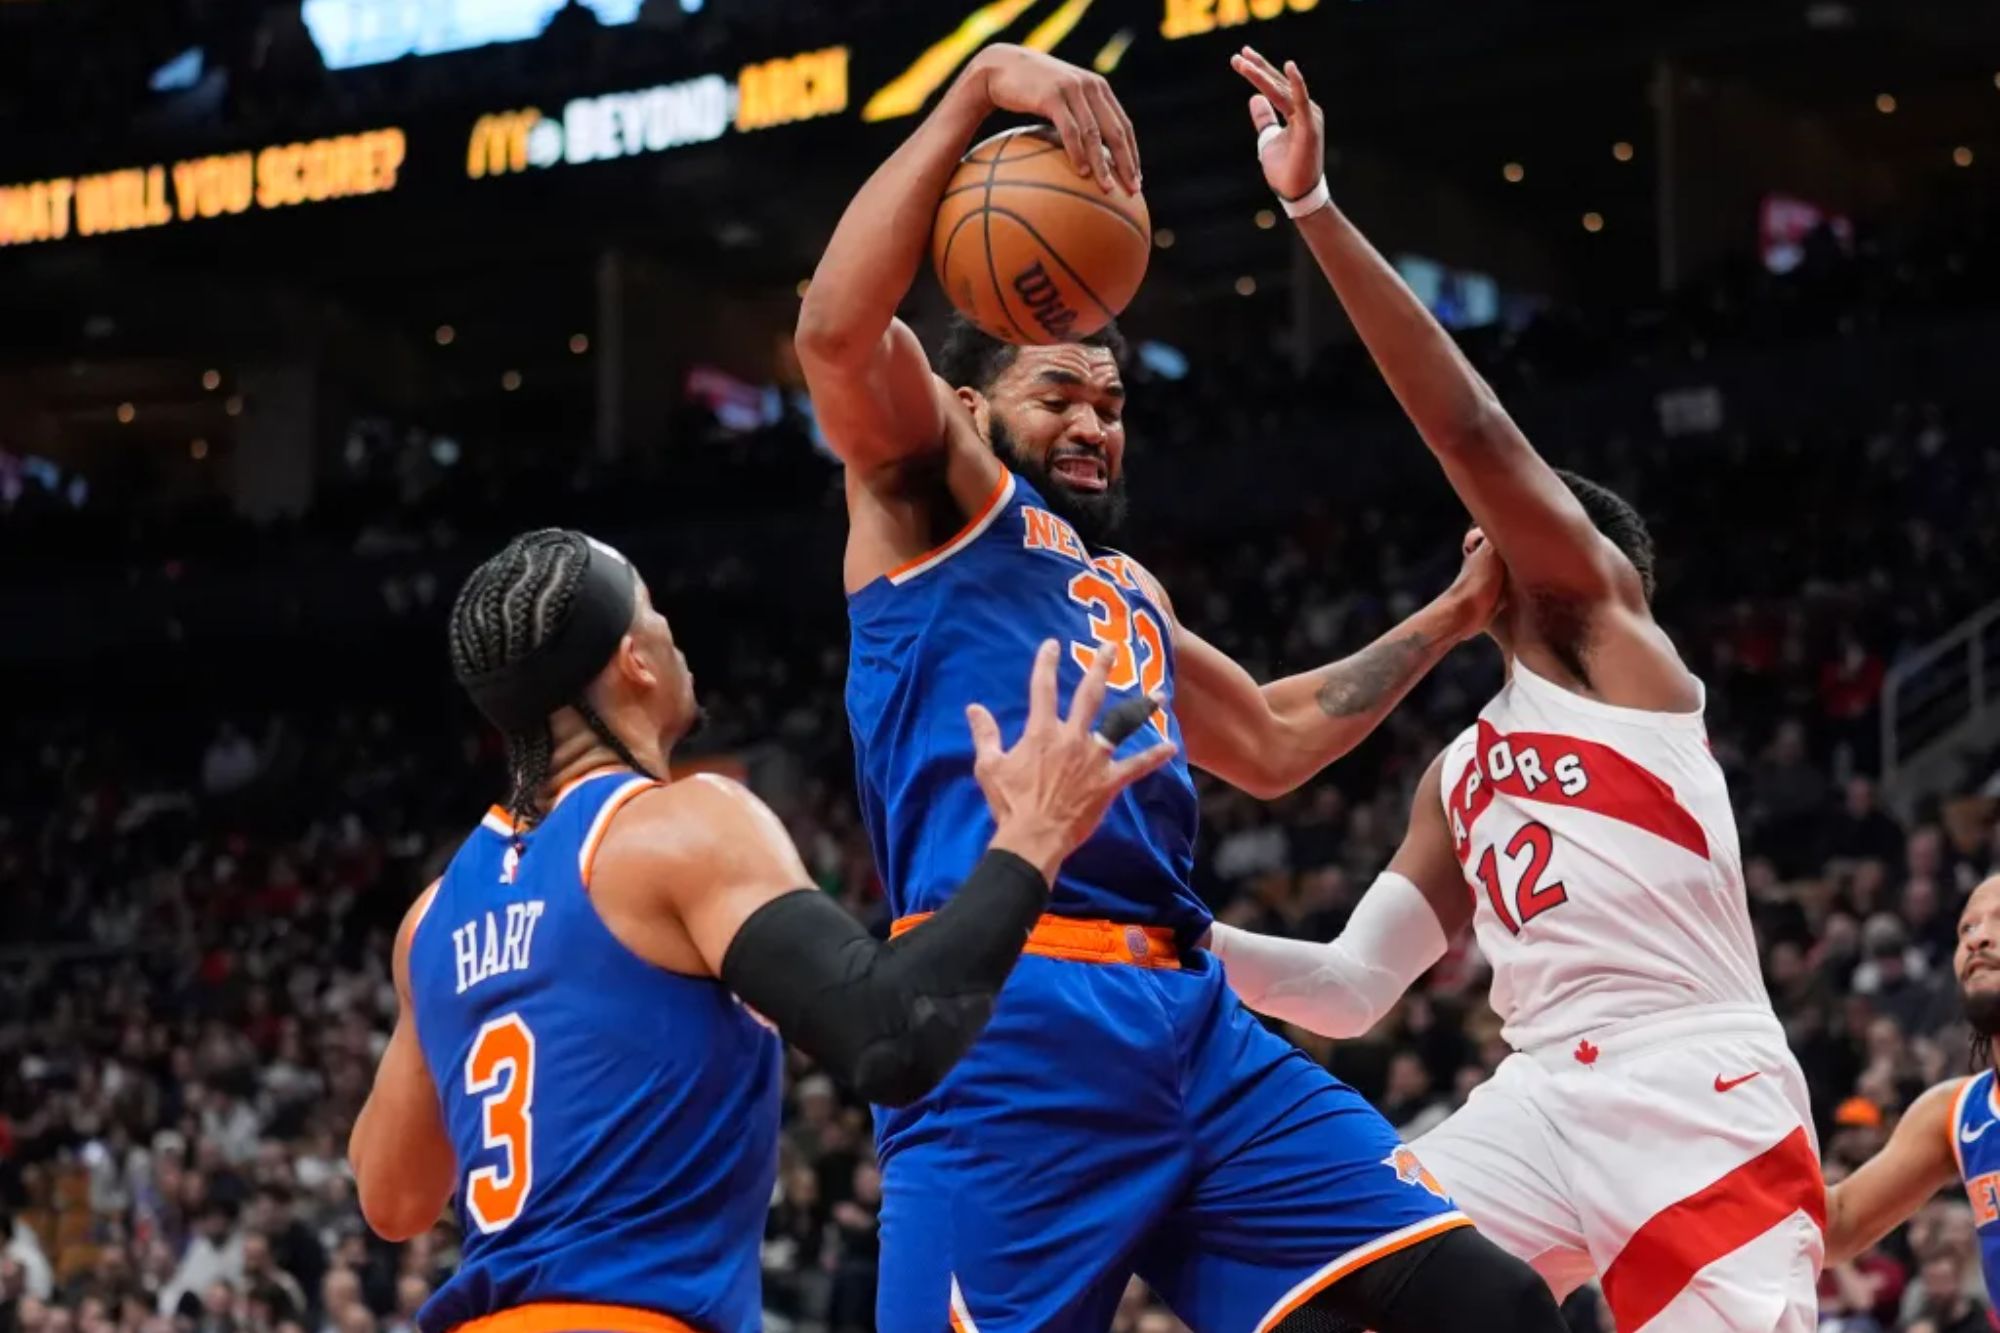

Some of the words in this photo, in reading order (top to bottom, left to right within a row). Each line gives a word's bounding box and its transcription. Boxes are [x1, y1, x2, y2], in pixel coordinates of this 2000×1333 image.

[564, 75, 727, 163] BEYOND
[76, 164, 171, 235] WILL
[173, 151, 253, 220] YOU
[257, 127, 405, 208] SCORE?
[1068, 571, 1168, 743] 32
[1476, 820, 1569, 937] 12
[452, 900, 545, 995] HART
[465, 1012, 535, 1234] 3
